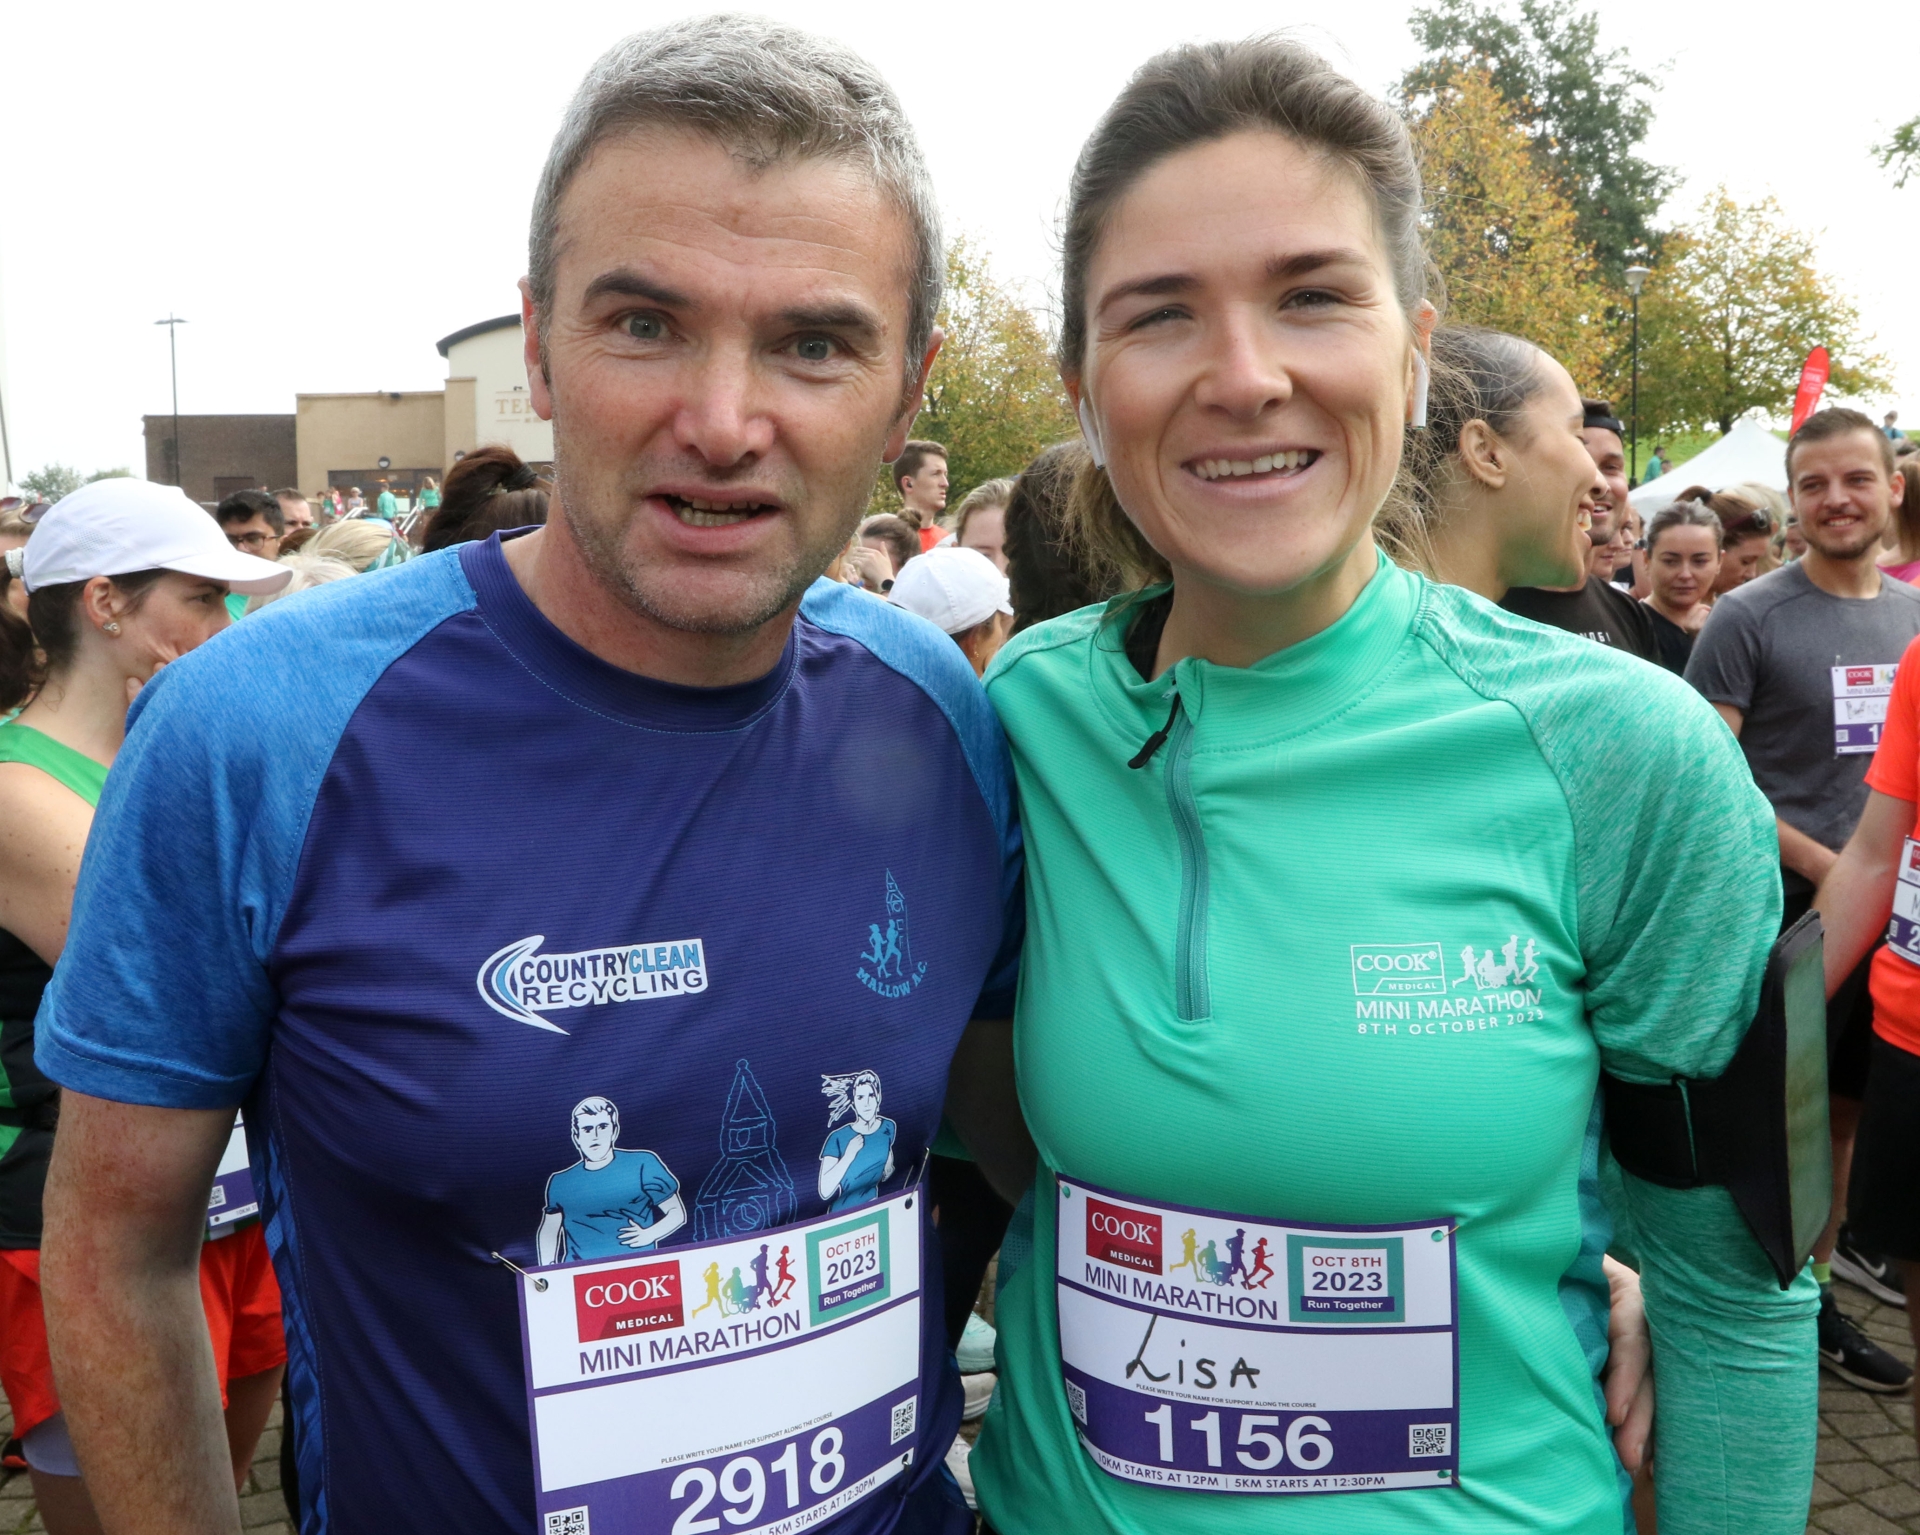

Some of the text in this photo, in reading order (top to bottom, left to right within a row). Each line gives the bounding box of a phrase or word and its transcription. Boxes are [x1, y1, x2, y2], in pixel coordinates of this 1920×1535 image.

[523, 969, 703, 1006] RECYCLING
[856, 966, 911, 998] MALLOW
[1388, 982, 1437, 991] MEDICAL
[1356, 988, 1542, 1020] MINI MARATHON
[1357, 1008, 1544, 1035] 8TH OCTOBER 2023
[826, 1232, 875, 1259] OCT 8TH
[1109, 1249, 1154, 1268] MEDICAL
[1312, 1255, 1382, 1268] OCT 8TH
[826, 1250, 876, 1286] 2023
[1312, 1271, 1383, 1292] 2023
[823, 1280, 877, 1307] Run Together
[1085, 1262, 1278, 1321] MINI MARATHON
[1307, 1300, 1383, 1311] Run Together
[615, 1312, 674, 1331] MEDICAL
[579, 1309, 801, 1375] MINI MARATHON
[1136, 1383, 1156, 1393] PLEASE
[1156, 1387, 1175, 1397] WRITE
[1175, 1391, 1192, 1400] YOUR
[1192, 1394, 1211, 1403] NAME
[1225, 1398, 1254, 1406] SUPPORT
[660, 1411, 833, 1464] PLEASE WRITE YOUR NAME FOR SUPPORT ALONG THE COURSE
[1144, 1403, 1334, 1471] 1156
[669, 1425, 846, 1535] 2918
[1097, 1452, 1386, 1489] 10KM STARTS AT 12PM 5KM STARTS AT 12:30PM
[768, 1475, 876, 1535] 5KM STARTS AT 12:30PM
